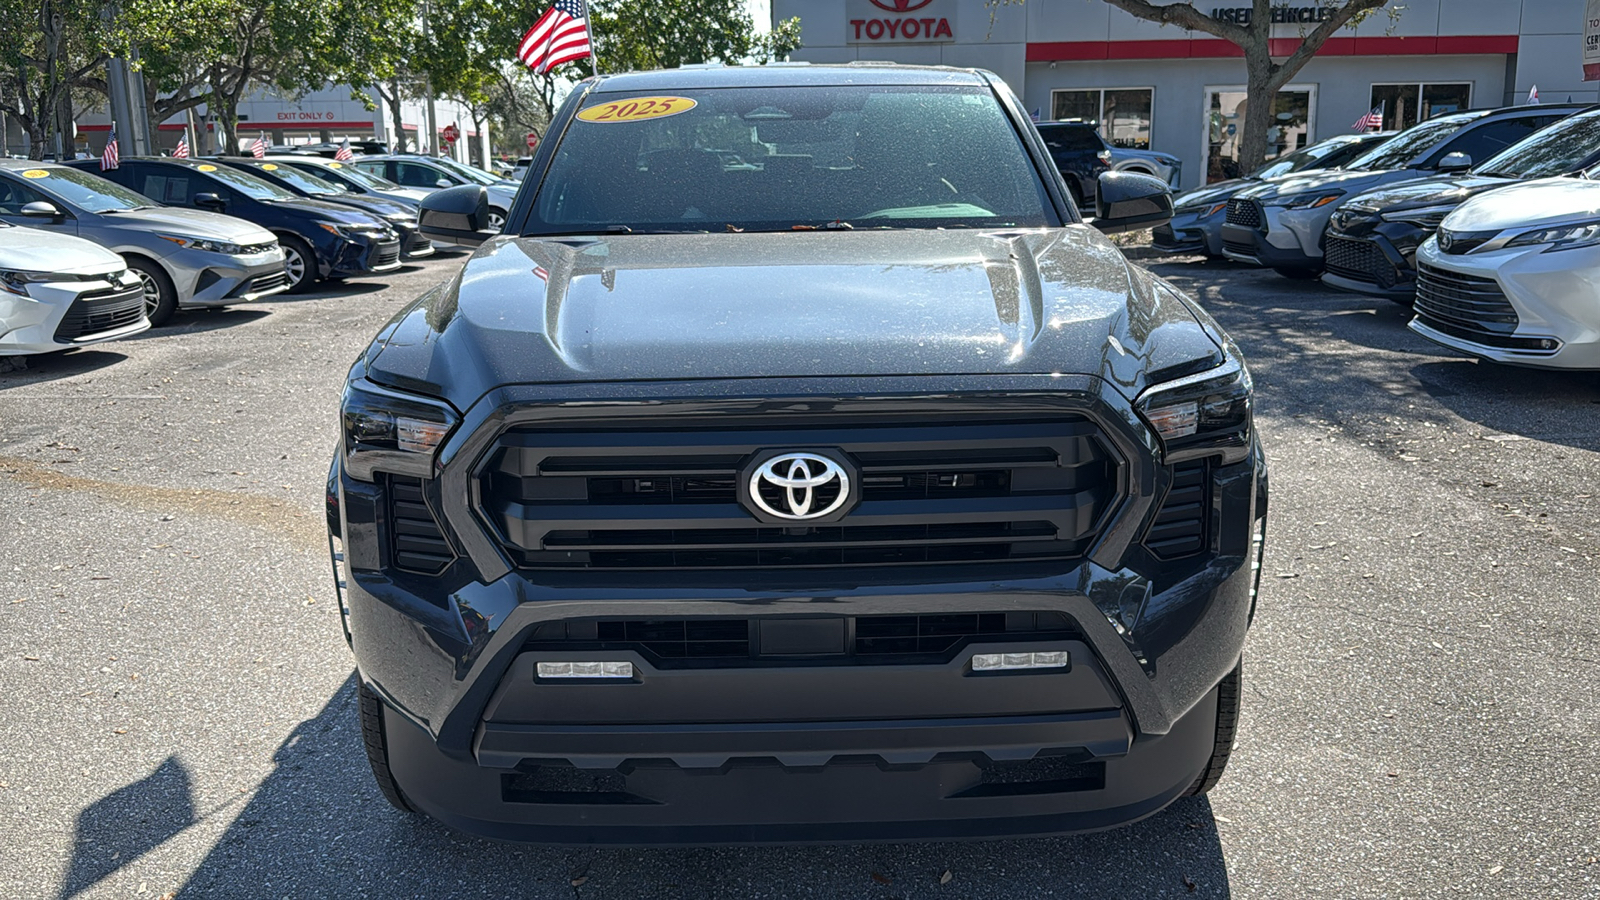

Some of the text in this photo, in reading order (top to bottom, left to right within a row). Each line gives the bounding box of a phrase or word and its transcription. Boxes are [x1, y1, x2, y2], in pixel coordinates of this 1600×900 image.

[1269, 7, 1338, 23] EHICLES
[850, 17, 953, 40] TOYOTA
[1586, 34, 1600, 45] CER
[277, 111, 323, 120] EXIT ONLY
[595, 99, 677, 120] 2025
